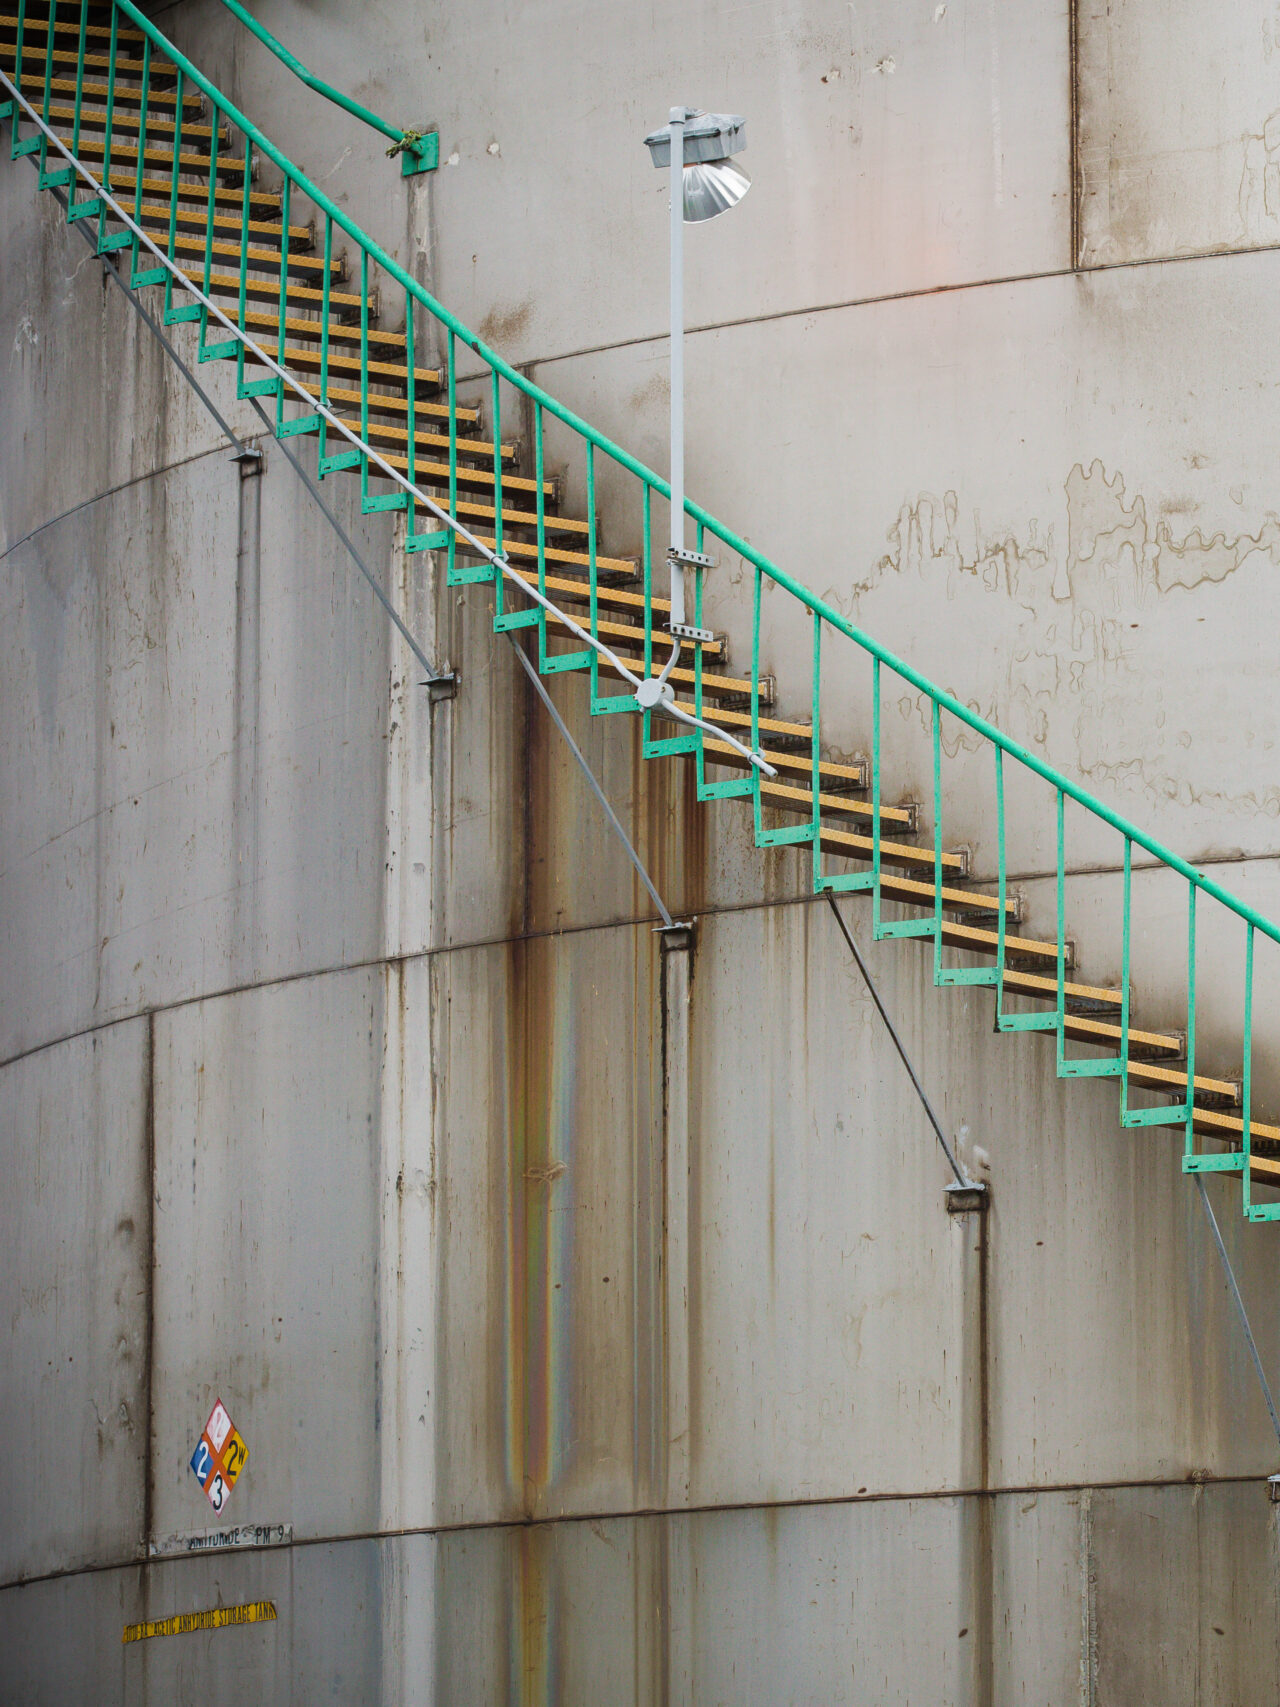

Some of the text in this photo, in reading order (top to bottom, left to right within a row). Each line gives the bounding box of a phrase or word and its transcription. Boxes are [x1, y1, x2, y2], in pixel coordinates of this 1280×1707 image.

[197, 1441, 210, 1478] 2
[212, 1474, 224, 1511] 3
[178, 1610, 215, 1631] ANHYDRIDE
[219, 1604, 250, 1625] STORAGE
